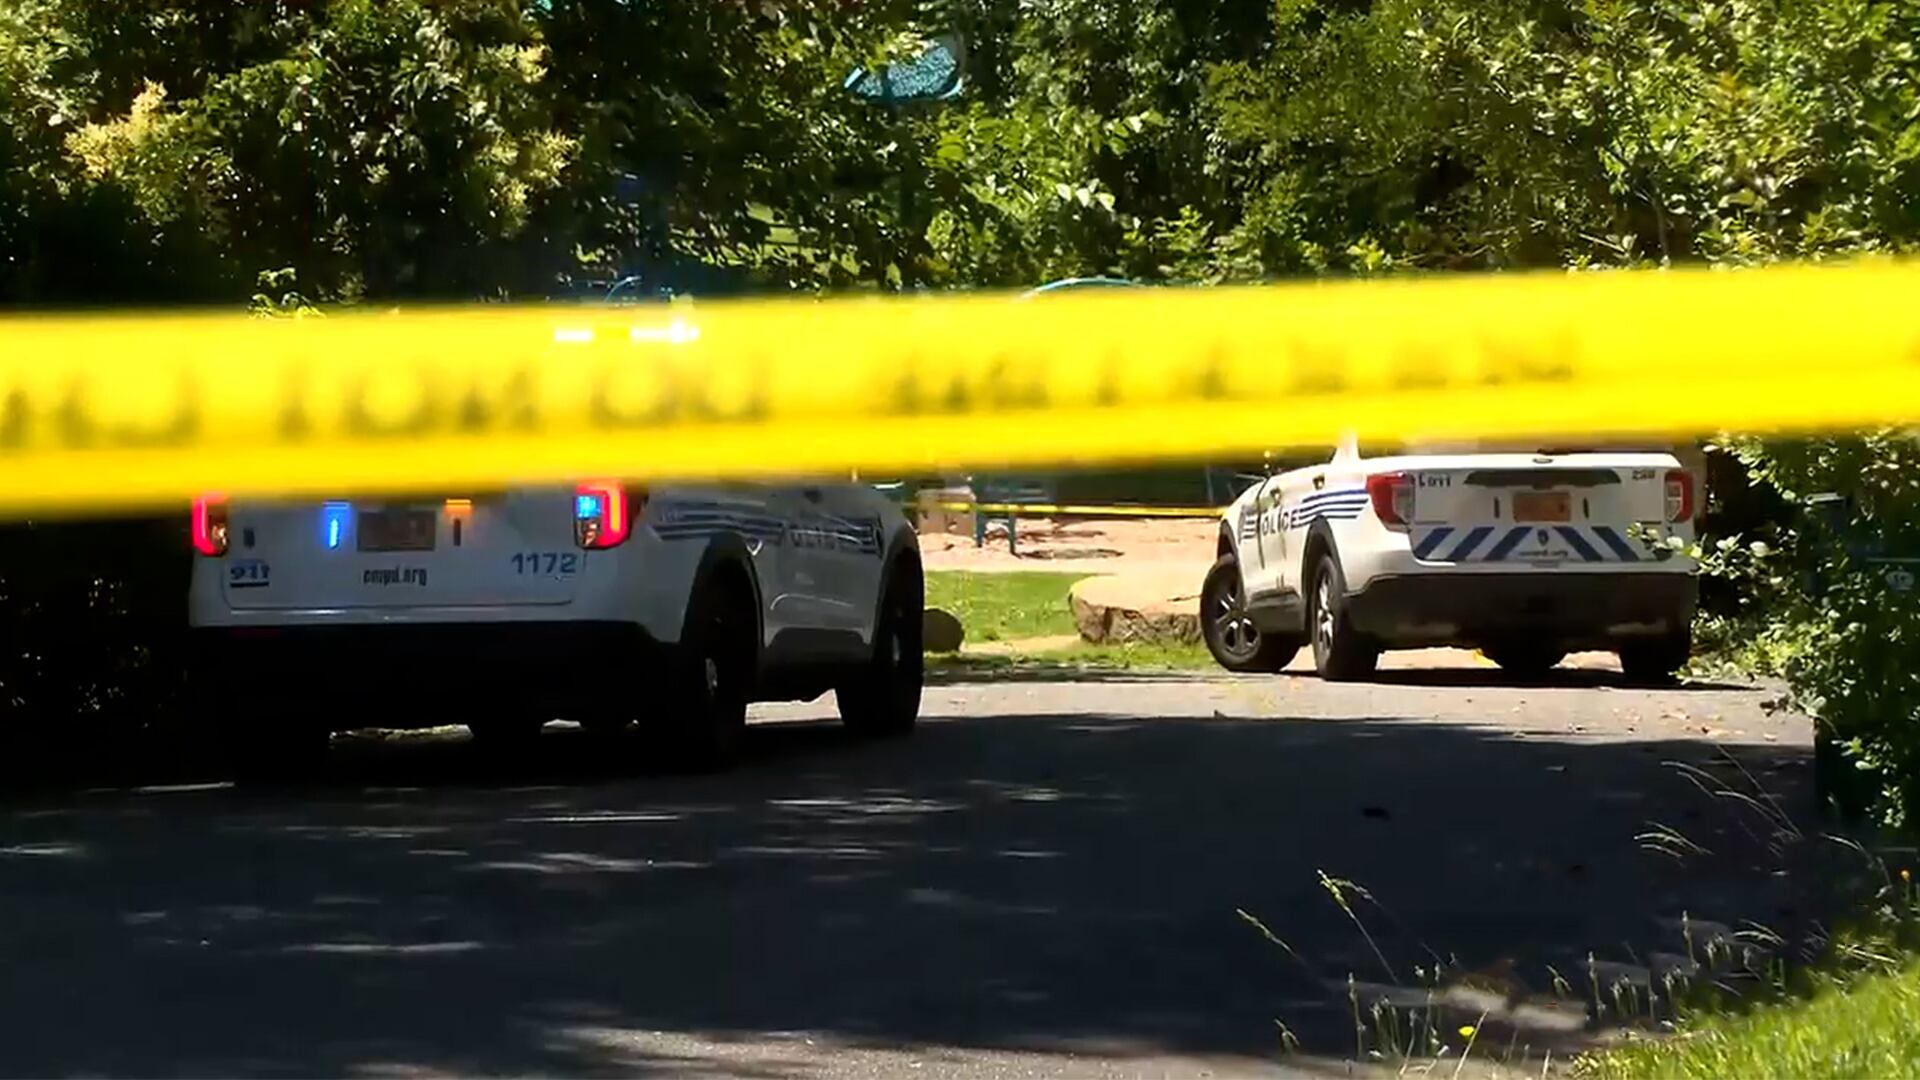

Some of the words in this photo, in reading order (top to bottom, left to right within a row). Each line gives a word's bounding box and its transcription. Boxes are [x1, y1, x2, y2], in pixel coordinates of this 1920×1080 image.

[1255, 509, 1299, 537] OLICE
[511, 552, 577, 574] 1172
[363, 564, 427, 586] cmpd.org
